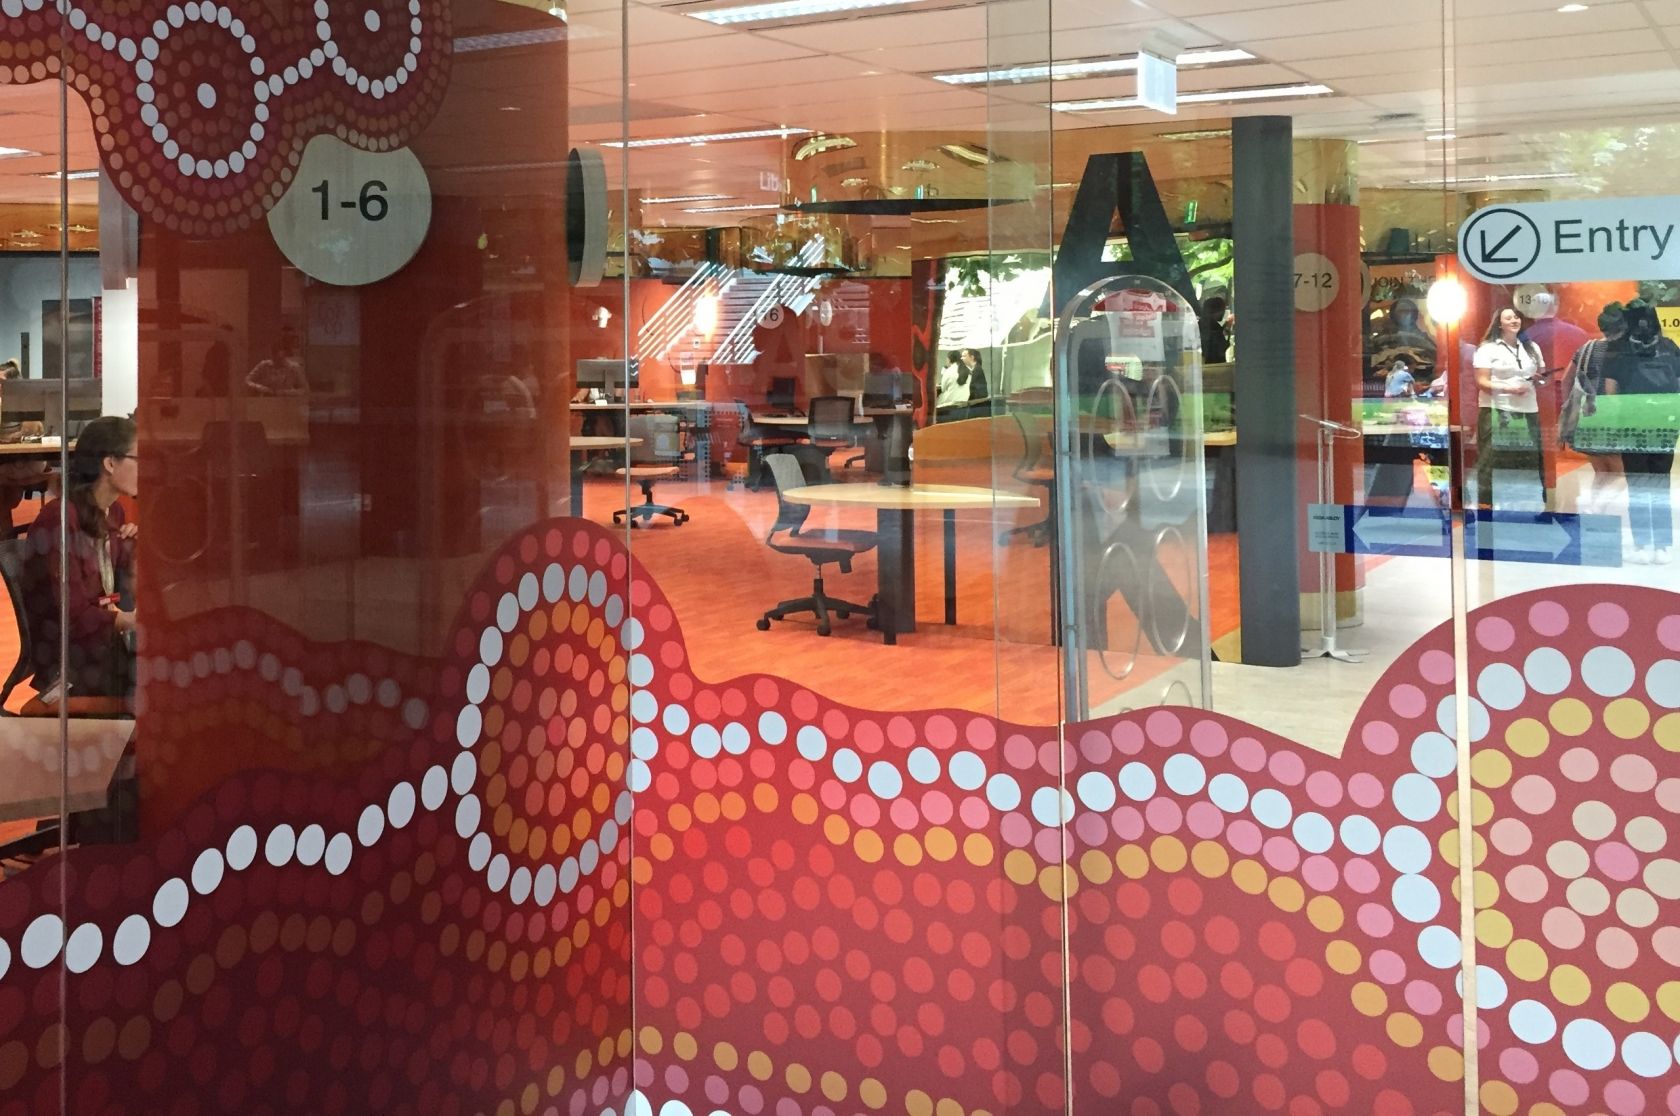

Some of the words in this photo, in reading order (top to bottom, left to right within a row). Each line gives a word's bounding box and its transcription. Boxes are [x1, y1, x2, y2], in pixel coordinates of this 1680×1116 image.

[311, 179, 389, 221] 1-6
[1554, 218, 1675, 261] Entry
[1294, 272, 1333, 288] 7-12
